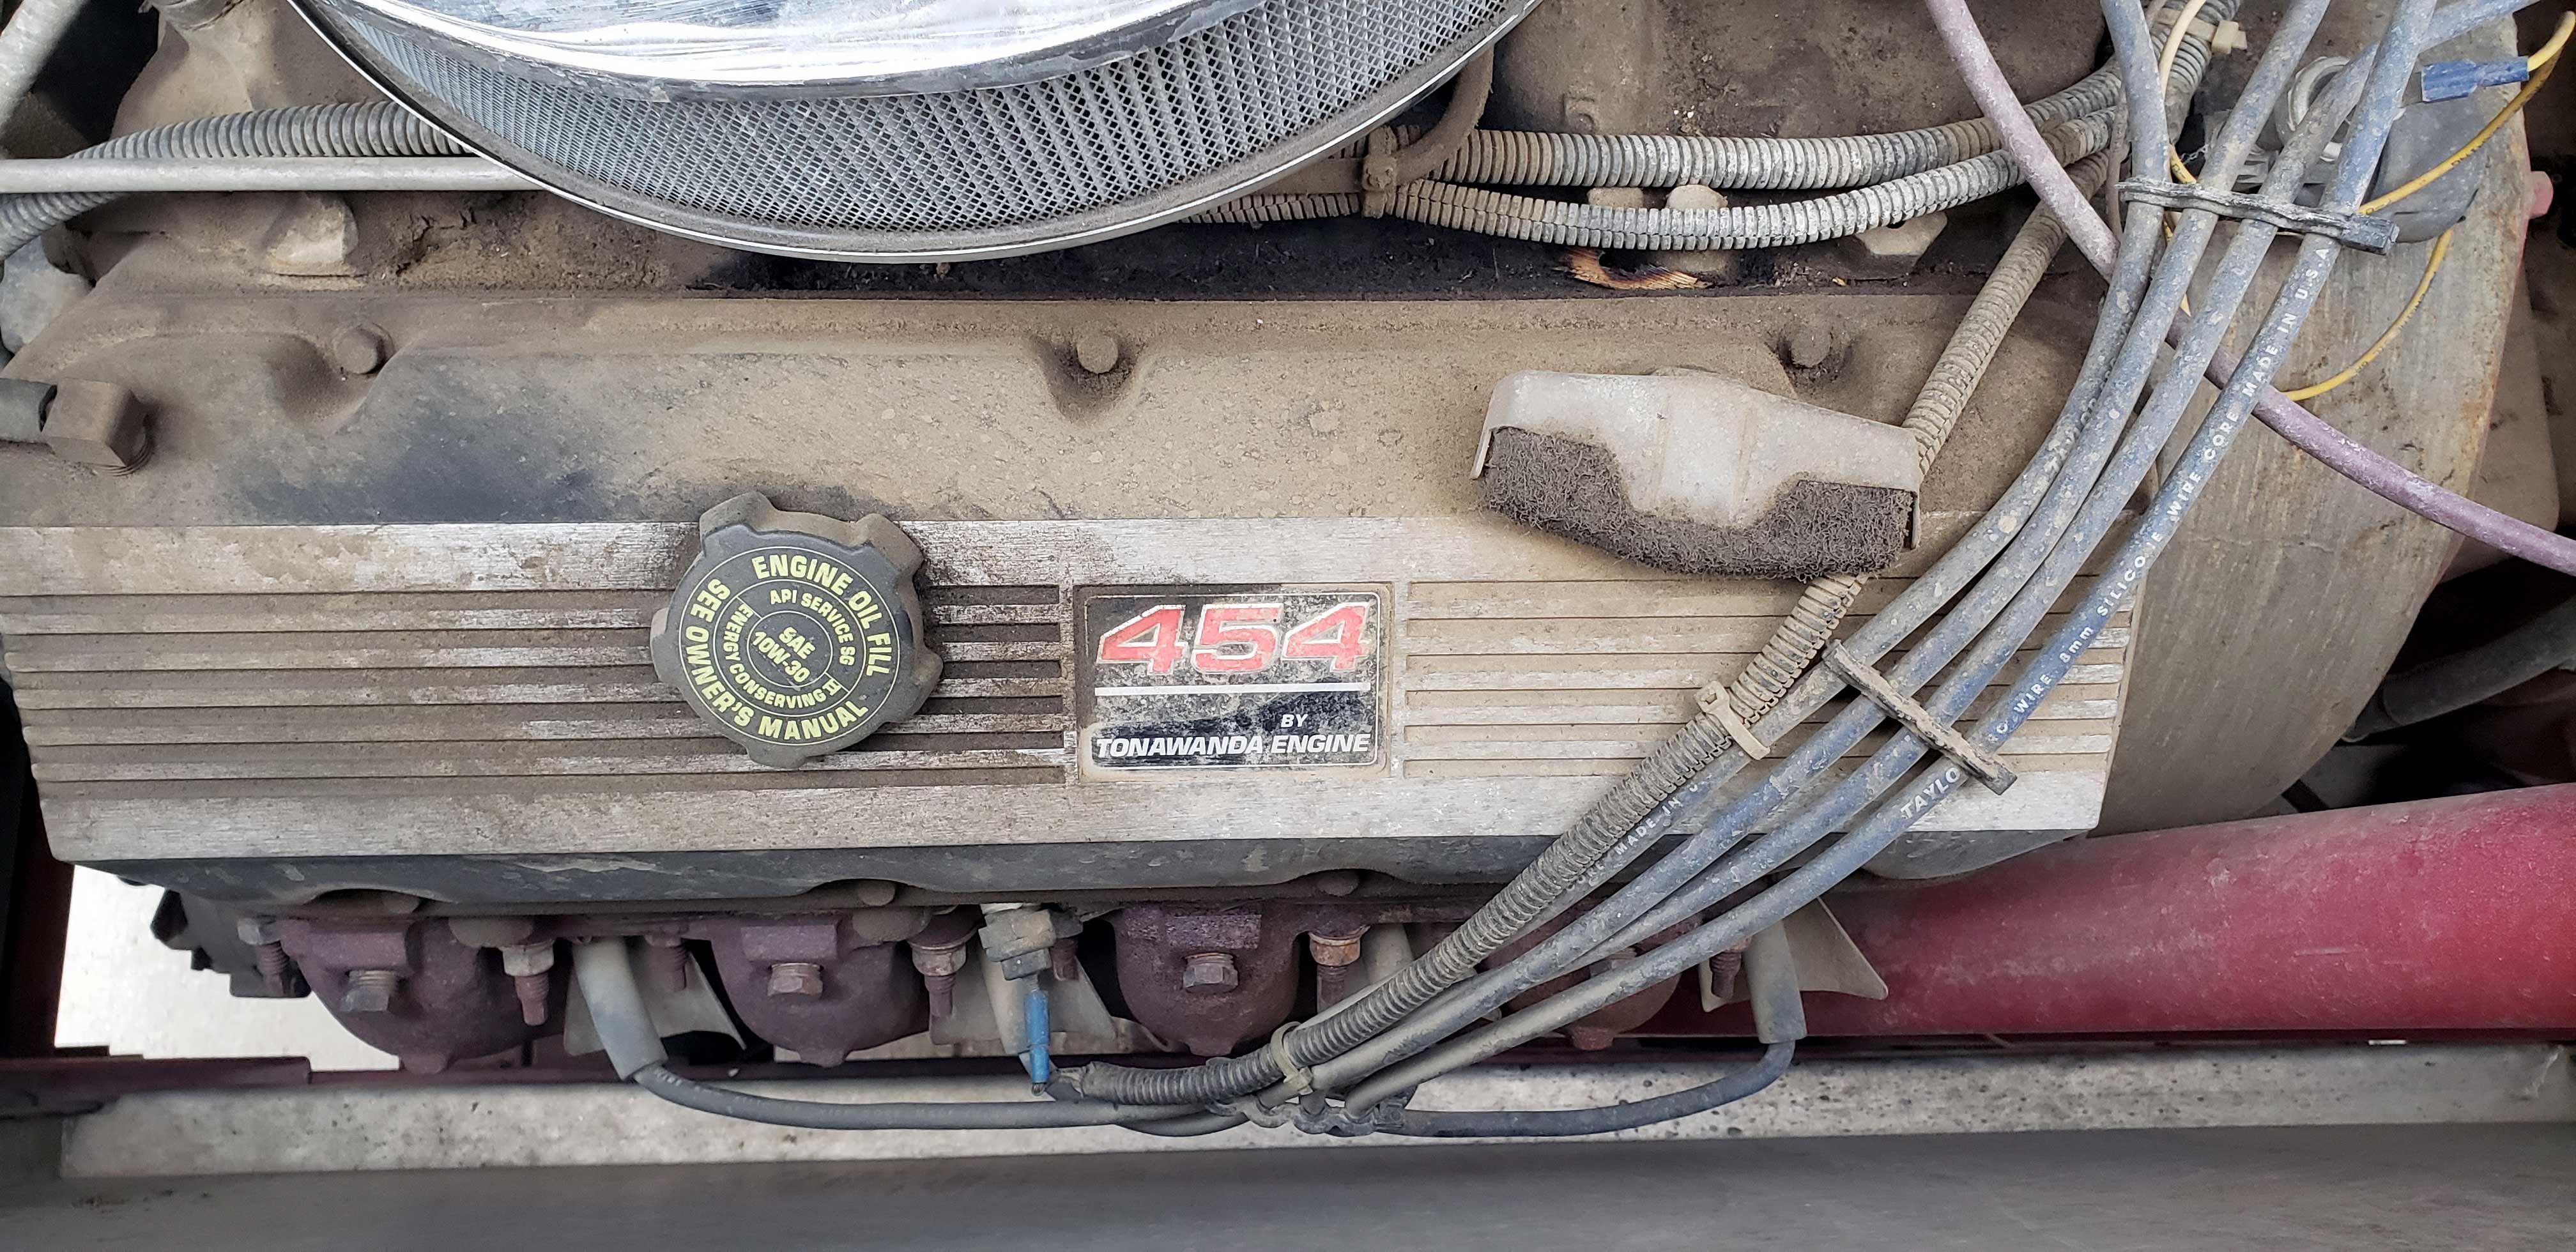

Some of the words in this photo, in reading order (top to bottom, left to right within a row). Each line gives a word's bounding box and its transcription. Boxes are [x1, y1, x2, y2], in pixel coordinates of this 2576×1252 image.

[1900, 766, 1961, 821] TAYLO
[2014, 675, 2051, 713] WIRE
[2059, 626, 2094, 664] 8mm
[2167, 471, 2202, 521] WIRE
[2204, 410, 2239, 461] CORE
[2242, 344, 2279, 397] MADE
[2277, 313, 2297, 333] IN
[691, 579, 732, 623] SEE
[751, 554, 854, 596] ENGINE
[848, 590, 882, 630] OIL
[866, 632, 893, 676] FILL
[770, 589, 797, 604] API
[801, 593, 854, 643] SERVICE
[839, 646, 855, 666] SG
[723, 604, 753, 660] ENERGY
[751, 631, 811, 683] 10W-30
[778, 626, 816, 659] SAE
[1096, 602, 1370, 675] 454
[686, 626, 755, 727] OWNER'S
[729, 664, 825, 708] CONSERVING
[758, 700, 868, 740] MANUAL
[1096, 735, 1262, 758] TONAWANDA
[1270, 734, 1370, 754] ENGINE
[1281, 714, 1308, 728] BY
[1614, 818, 1656, 855] MADE
[1662, 797, 1683, 816] IN
